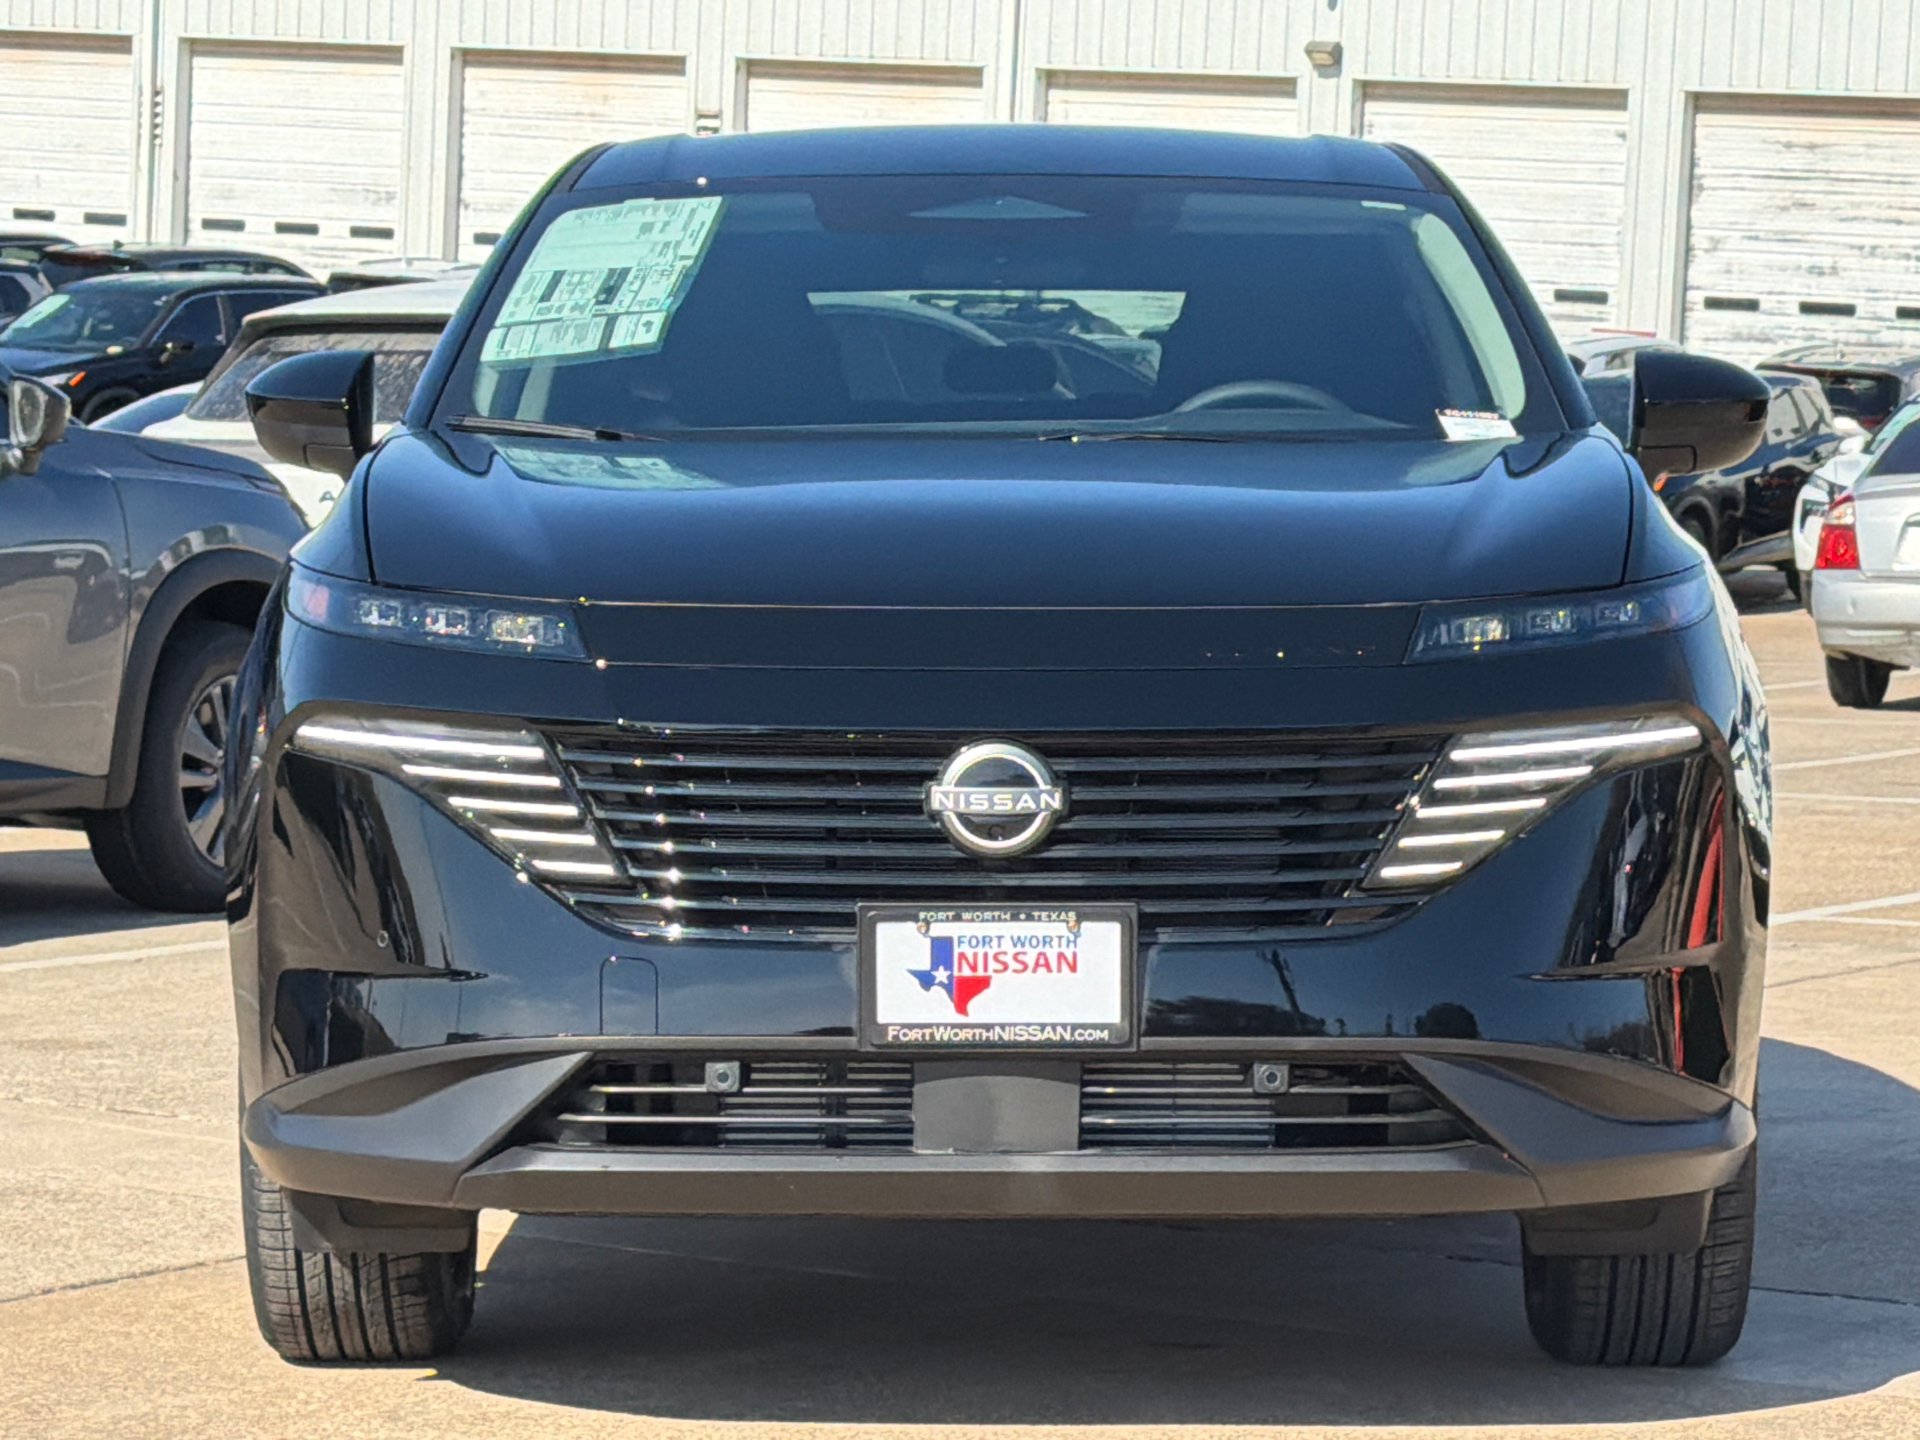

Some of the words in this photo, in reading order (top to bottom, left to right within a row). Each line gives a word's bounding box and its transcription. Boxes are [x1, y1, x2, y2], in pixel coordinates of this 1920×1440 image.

[935, 792, 1060, 811] NISSAN
[919, 911, 955, 922] FORT
[962, 911, 1011, 922] WORTH
[1032, 911, 1077, 922] TEXAS
[957, 935, 1005, 949] FORT
[1010, 935, 1078, 949] WORTH
[957, 951, 1078, 974] NISSAN
